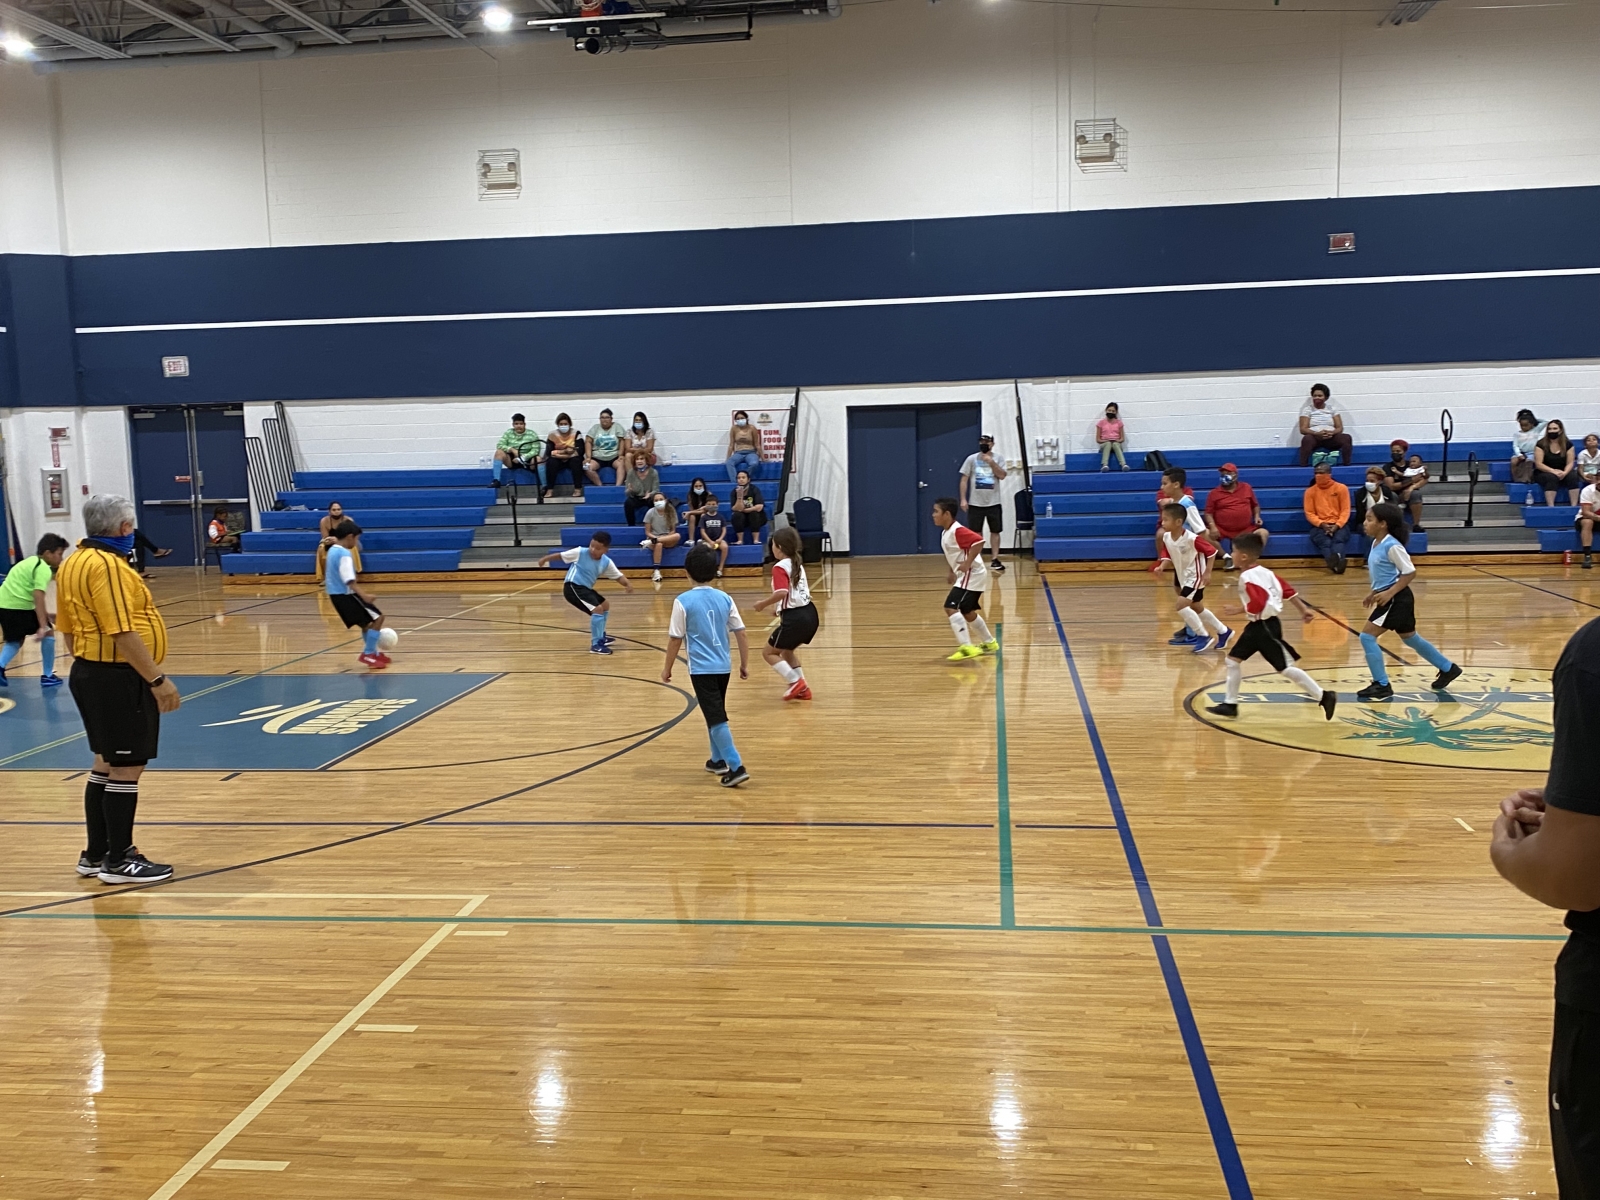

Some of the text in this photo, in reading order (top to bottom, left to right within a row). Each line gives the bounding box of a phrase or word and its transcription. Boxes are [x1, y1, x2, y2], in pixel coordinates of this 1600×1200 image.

[707, 610, 721, 646] 1
[280, 699, 388, 734] MIRAMAR
[317, 699, 418, 735] SPORTS
